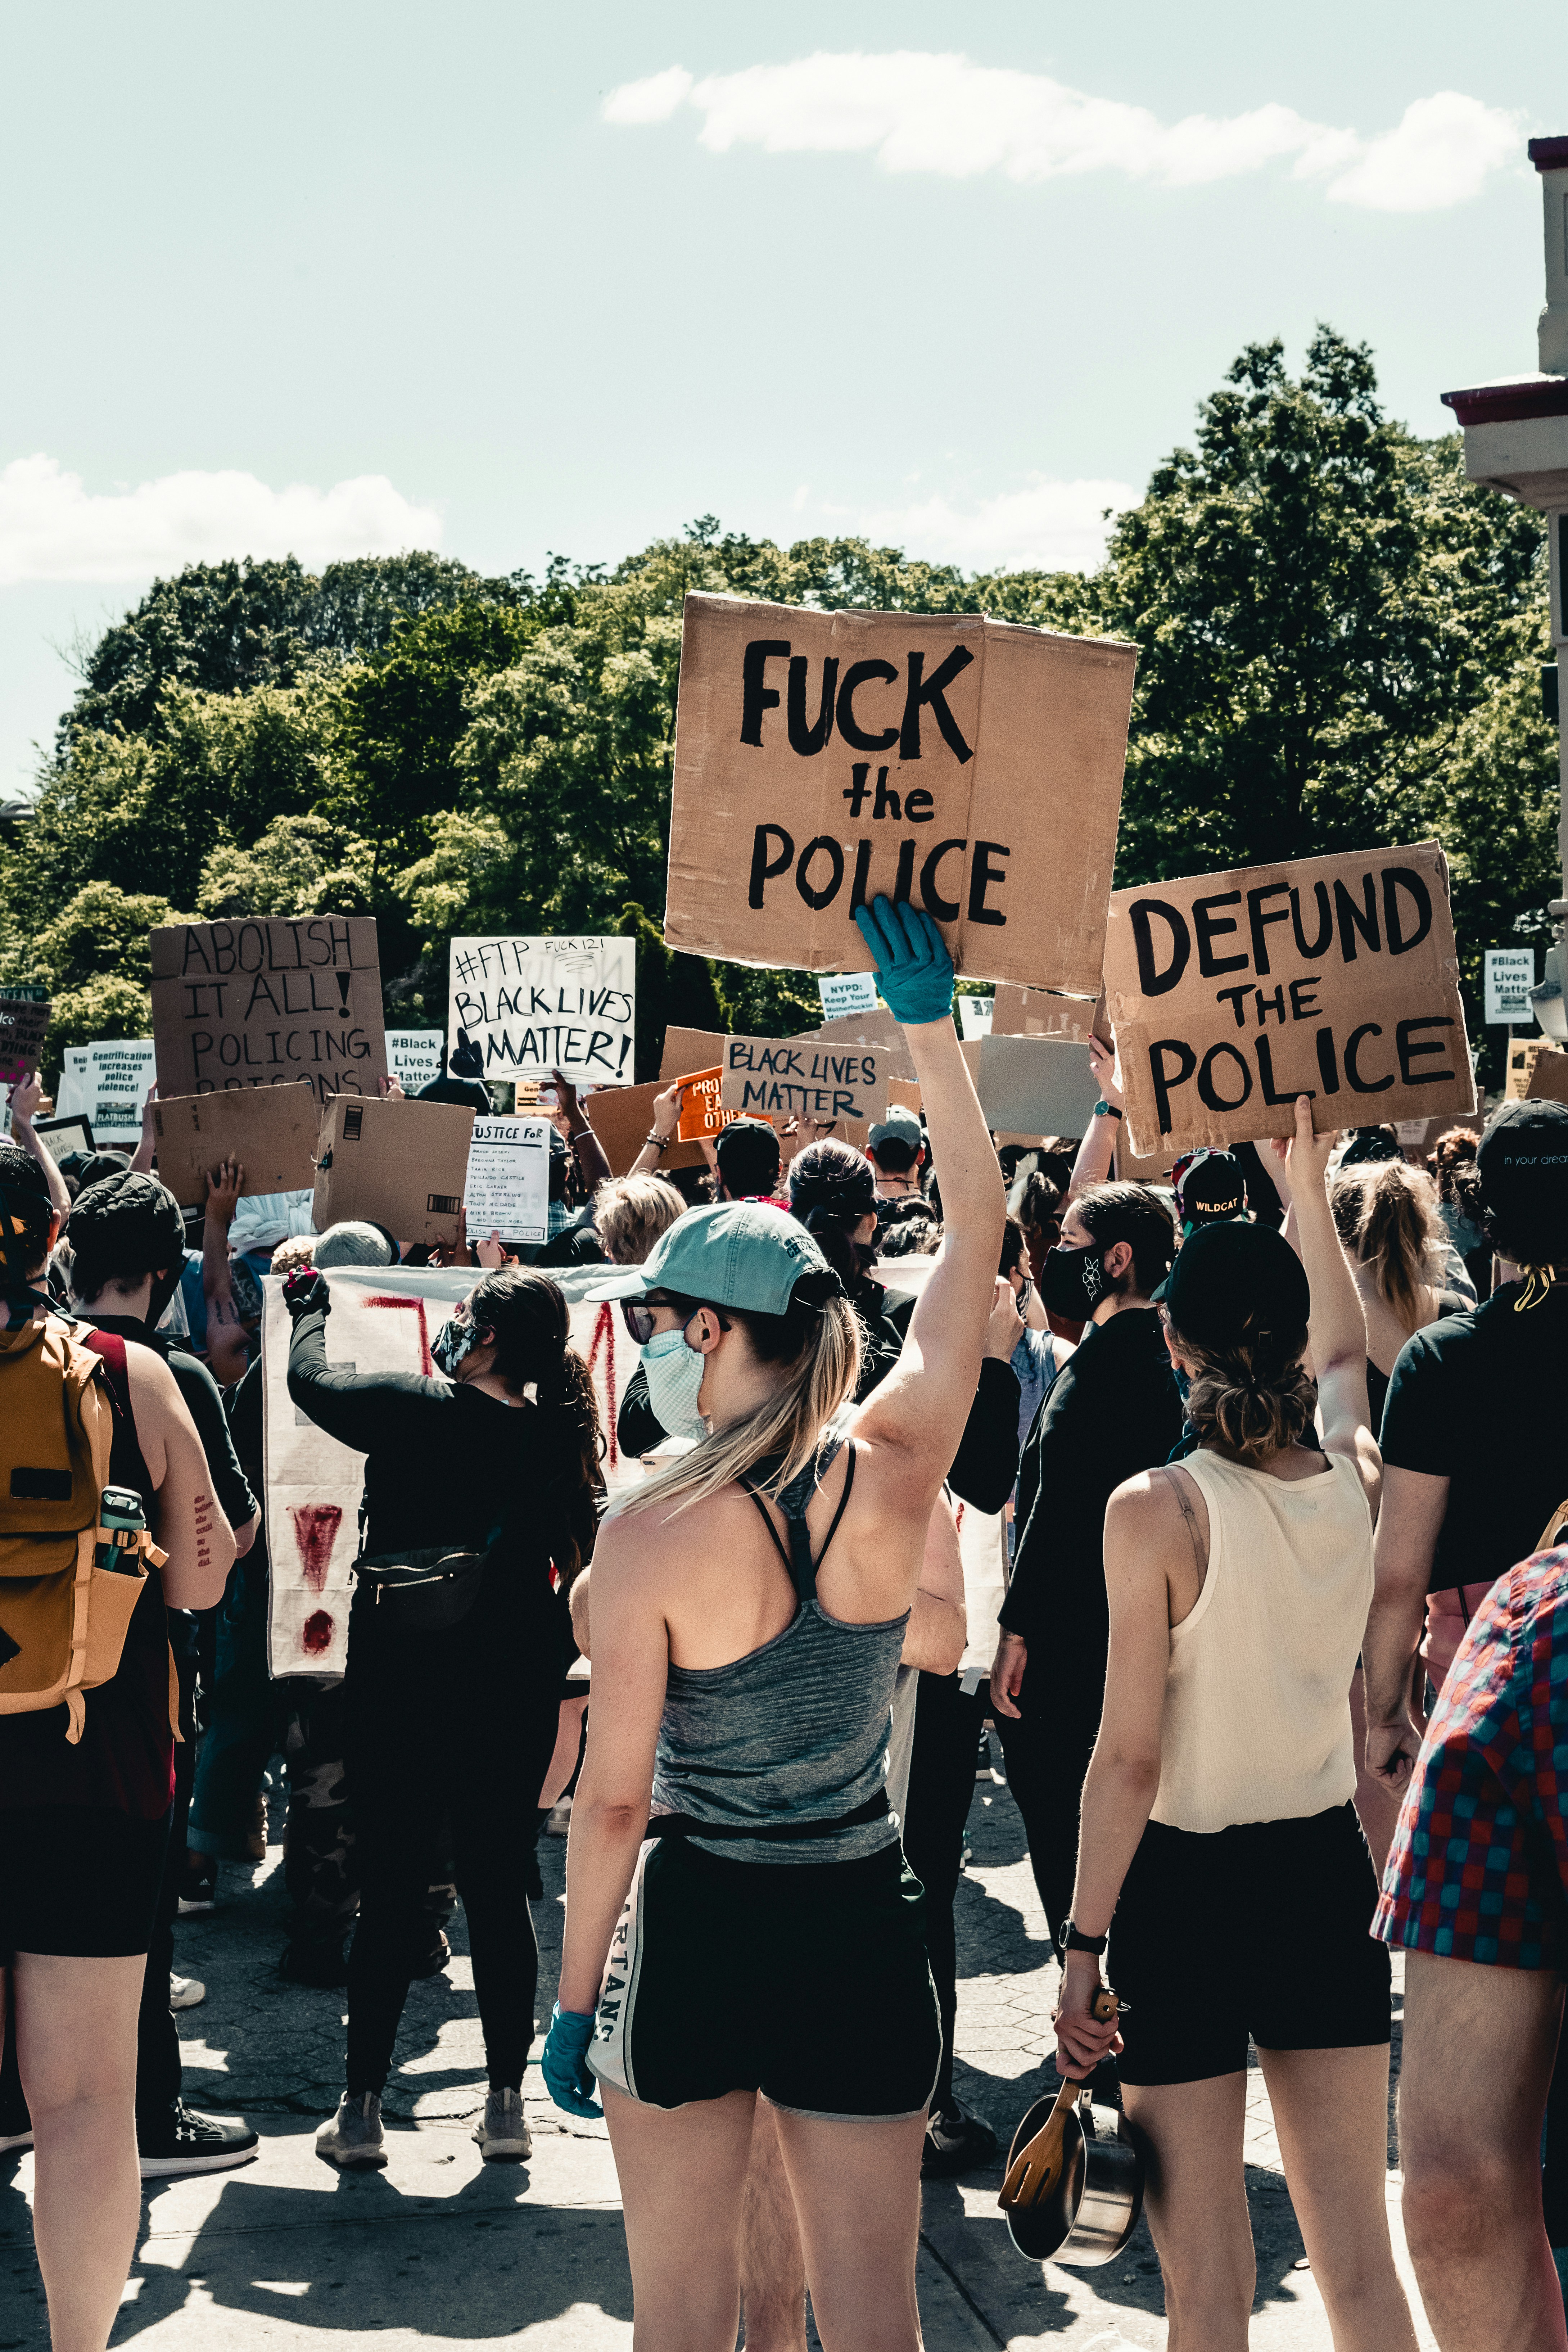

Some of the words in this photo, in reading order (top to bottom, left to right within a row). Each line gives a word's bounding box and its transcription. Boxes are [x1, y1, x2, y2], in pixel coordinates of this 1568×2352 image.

[740, 640, 974, 764] FUCK
[843, 762, 934, 822] the
[748, 823, 1010, 926] POLICE
[1129, 867, 1432, 997] DEFUND
[182, 922, 352, 976] ABOLISH
[456, 941, 529, 984] #FTP
[545, 939, 578, 953] FUCK
[582, 939, 604, 952] 12!
[1491, 956, 1529, 966] #Black
[831, 984, 863, 993] NYPD:
[1494, 971, 1527, 981] Lives
[1495, 985, 1532, 993] Matte
[185, 983, 228, 1019] IT
[244, 972, 351, 1021] ALL!
[455, 986, 552, 1030] BLACK
[558, 987, 633, 1022] LIVES
[1217, 976, 1323, 1027] THE
[92, 1051, 152, 1061] Gentrification
[192, 1029, 371, 1077] POLICING
[392, 1038, 436, 1048] #Black
[487, 1026, 634, 1078] MATTER!
[395, 1055, 433, 1066] Lives
[729, 1042, 805, 1077] BLACK
[811, 1053, 876, 1085] LIVES
[98, 1082, 139, 1092] violence!
[105, 1072, 133, 1081] police
[1149, 1017, 1455, 1135] POLICE
[741, 1080, 864, 1118] MATTER
[1505, 1155, 1511, 1164] in
[1515, 1157, 1537, 1166] your
[1196, 1197, 1238, 1212] WILDCAT
[195, 1515, 207, 1524] she
[196, 1522, 213, 1534] could
[198, 1548, 210, 1557] she
